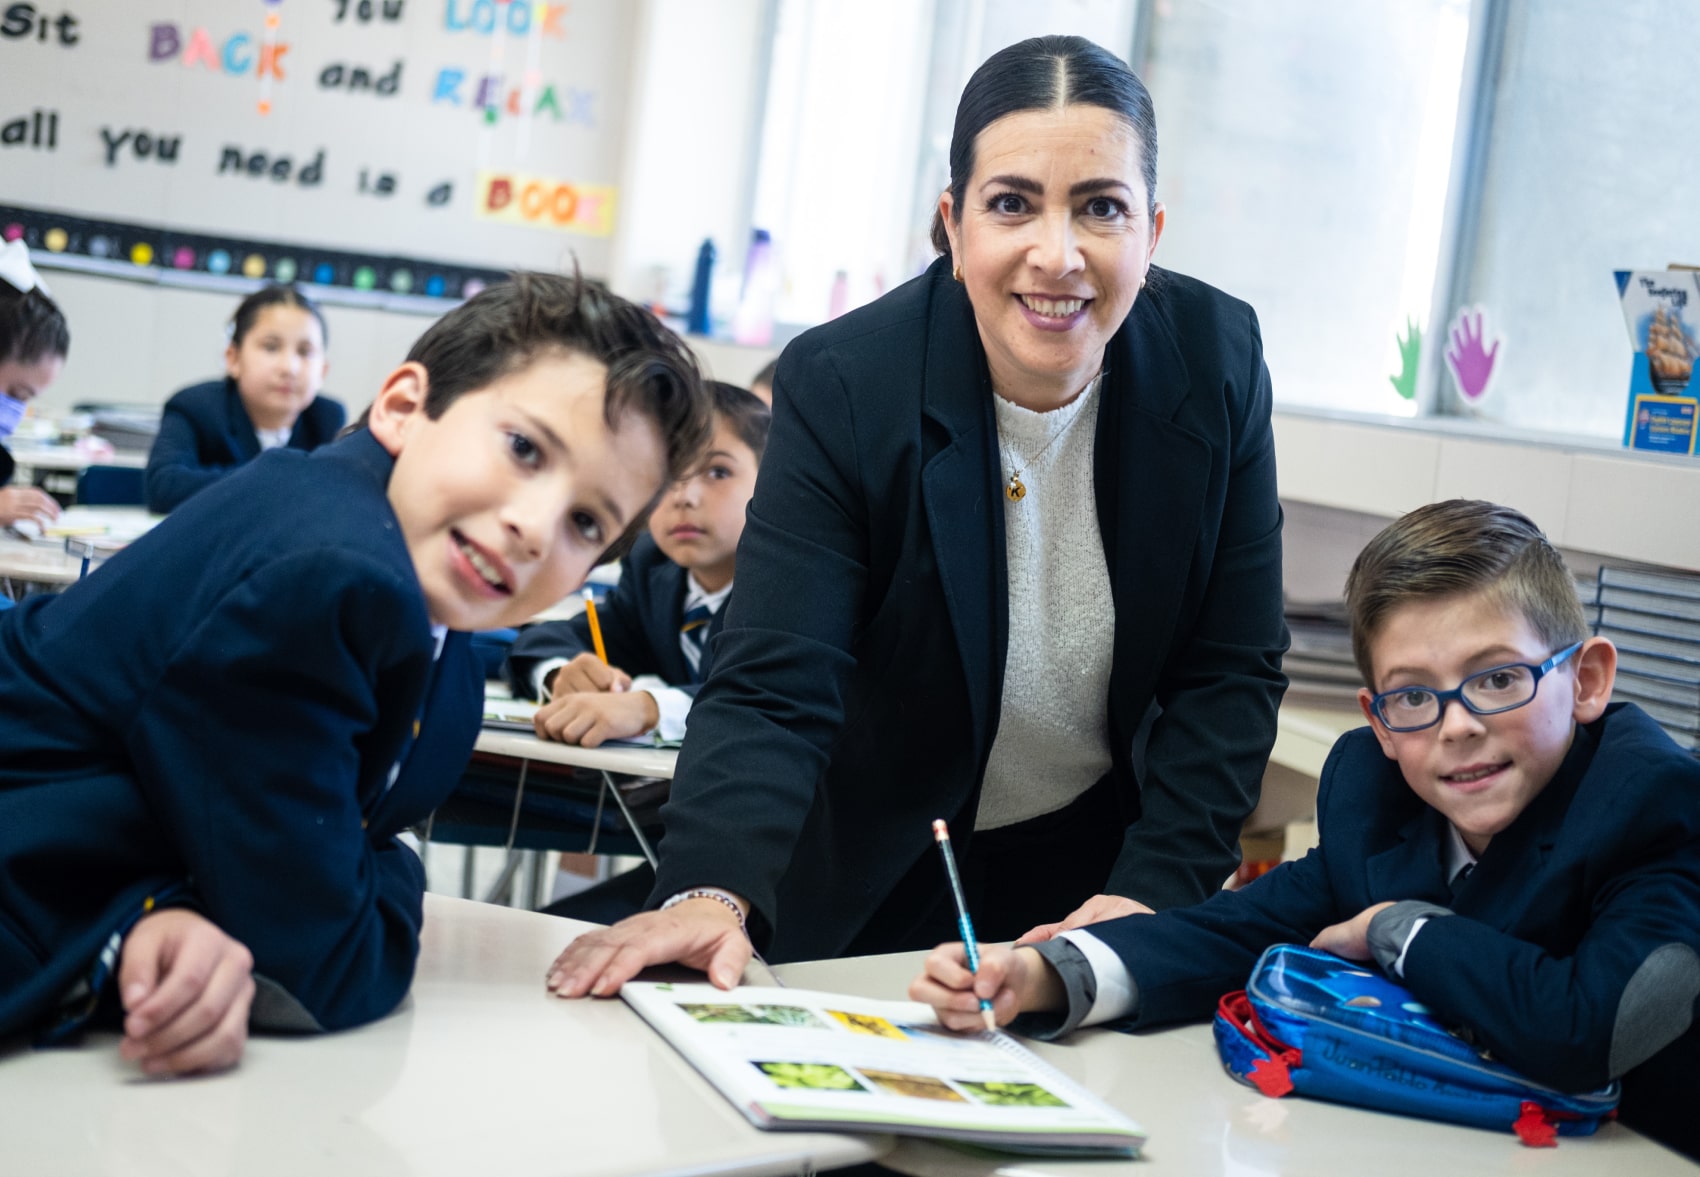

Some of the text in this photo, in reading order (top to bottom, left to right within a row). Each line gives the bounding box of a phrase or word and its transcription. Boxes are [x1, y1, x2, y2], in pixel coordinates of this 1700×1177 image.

[0, 3, 79, 47] Sit
[148, 20, 290, 80] BACK
[318, 58, 404, 98] and
[0, 109, 59, 148] all
[100, 128, 182, 168] you
[217, 144, 325, 188] need
[425, 180, 453, 208] a
[484, 177, 603, 234] BOOK
[1010, 486, 1021, 498] K
